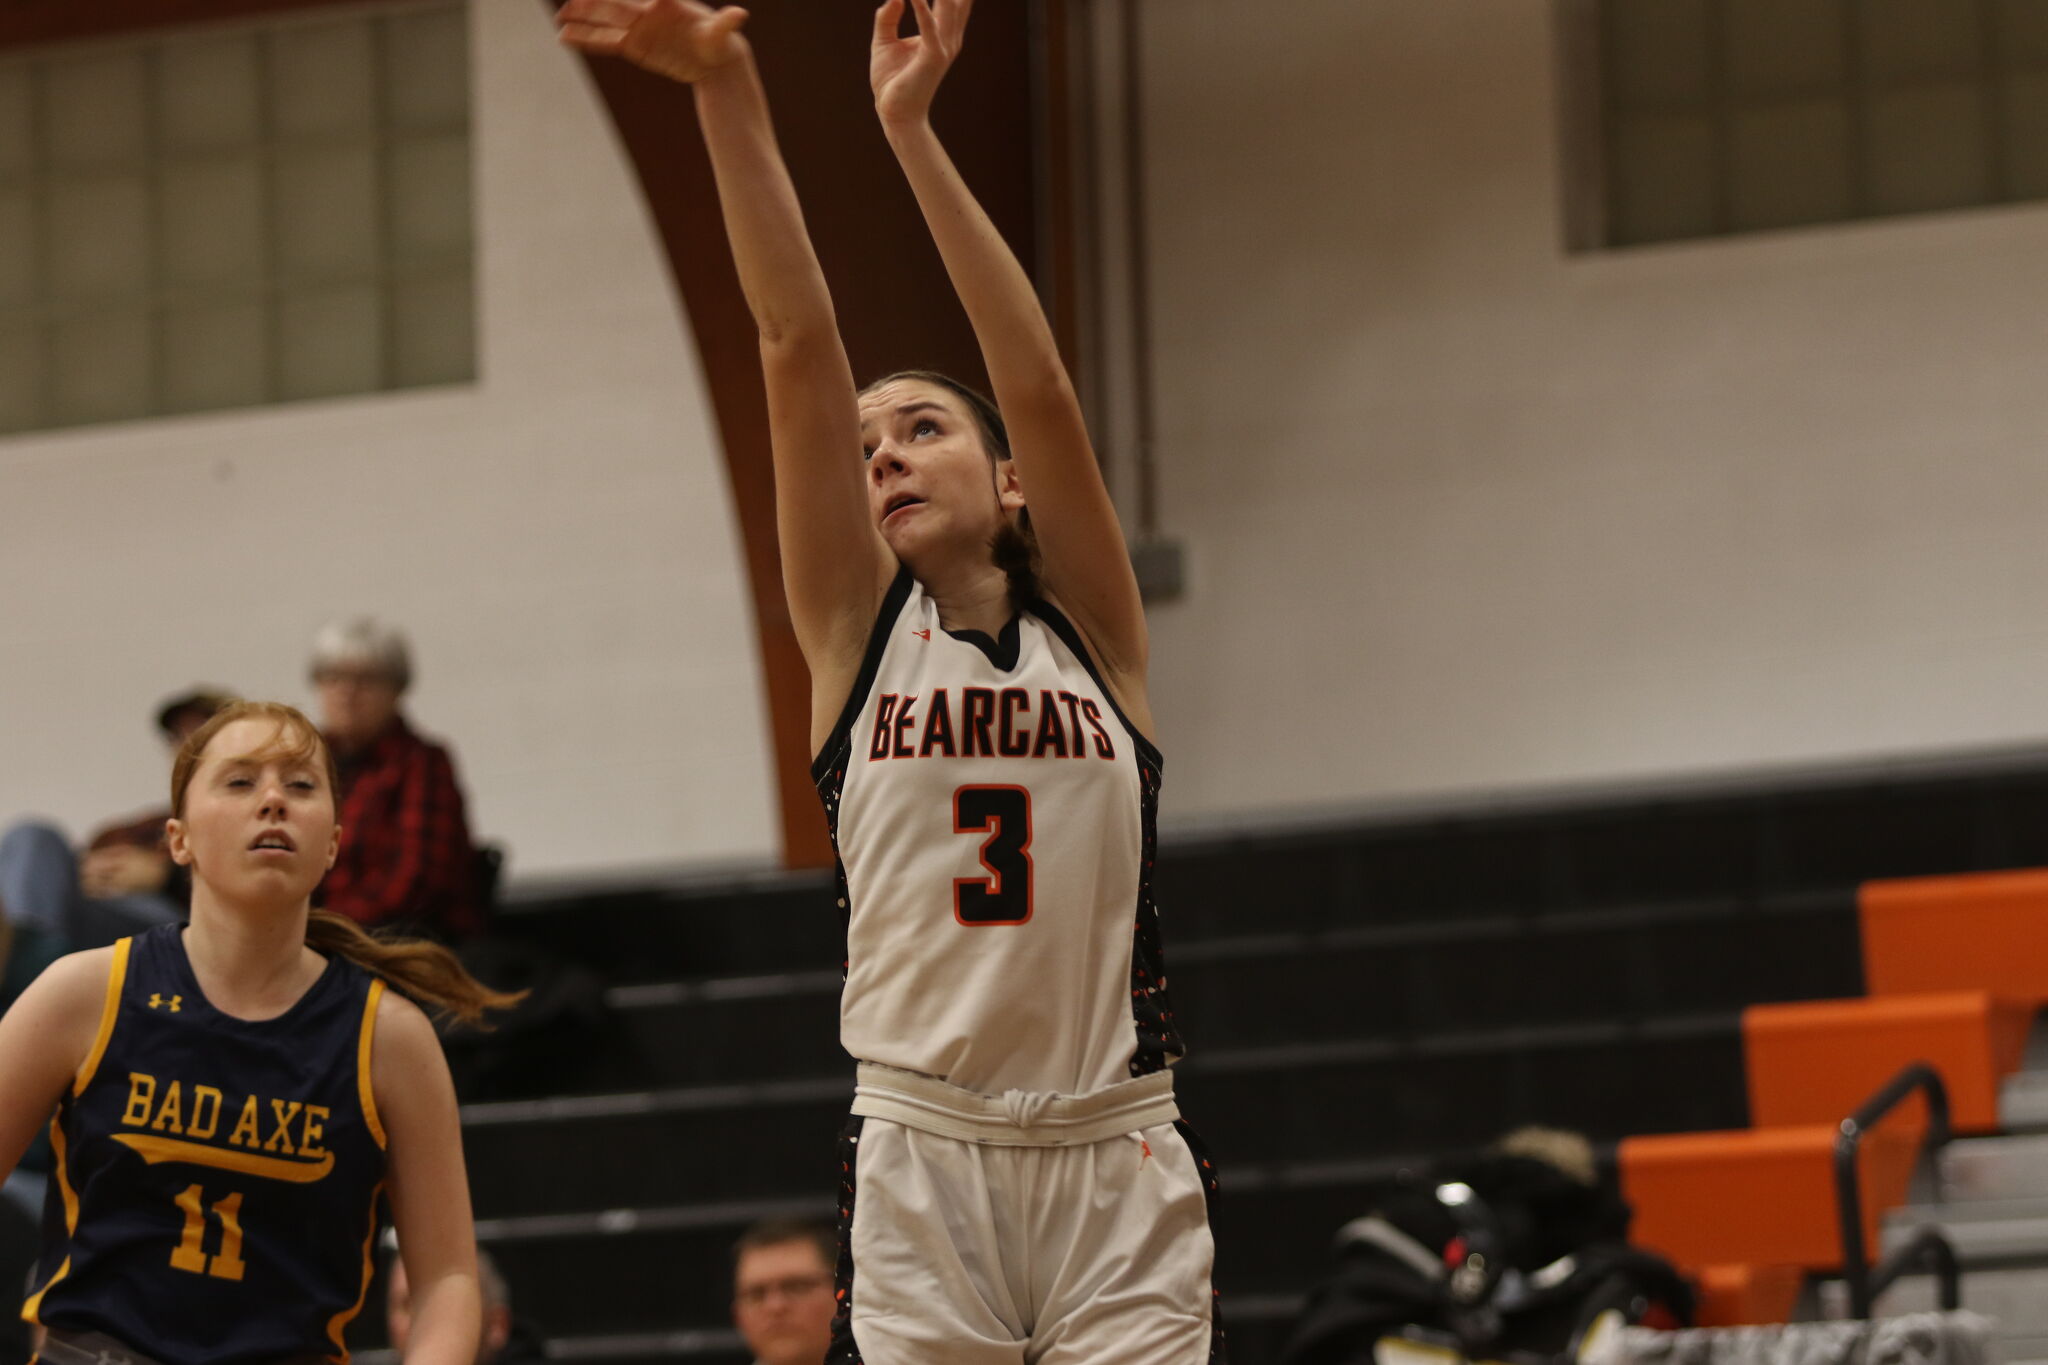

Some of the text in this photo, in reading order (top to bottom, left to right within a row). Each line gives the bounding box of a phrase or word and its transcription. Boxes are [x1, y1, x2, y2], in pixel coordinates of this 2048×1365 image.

[869, 687, 1116, 762] BEARCATS
[953, 783, 1034, 927] 3
[121, 1072, 330, 1159] BAD AXE
[169, 1184, 245, 1281] 11
